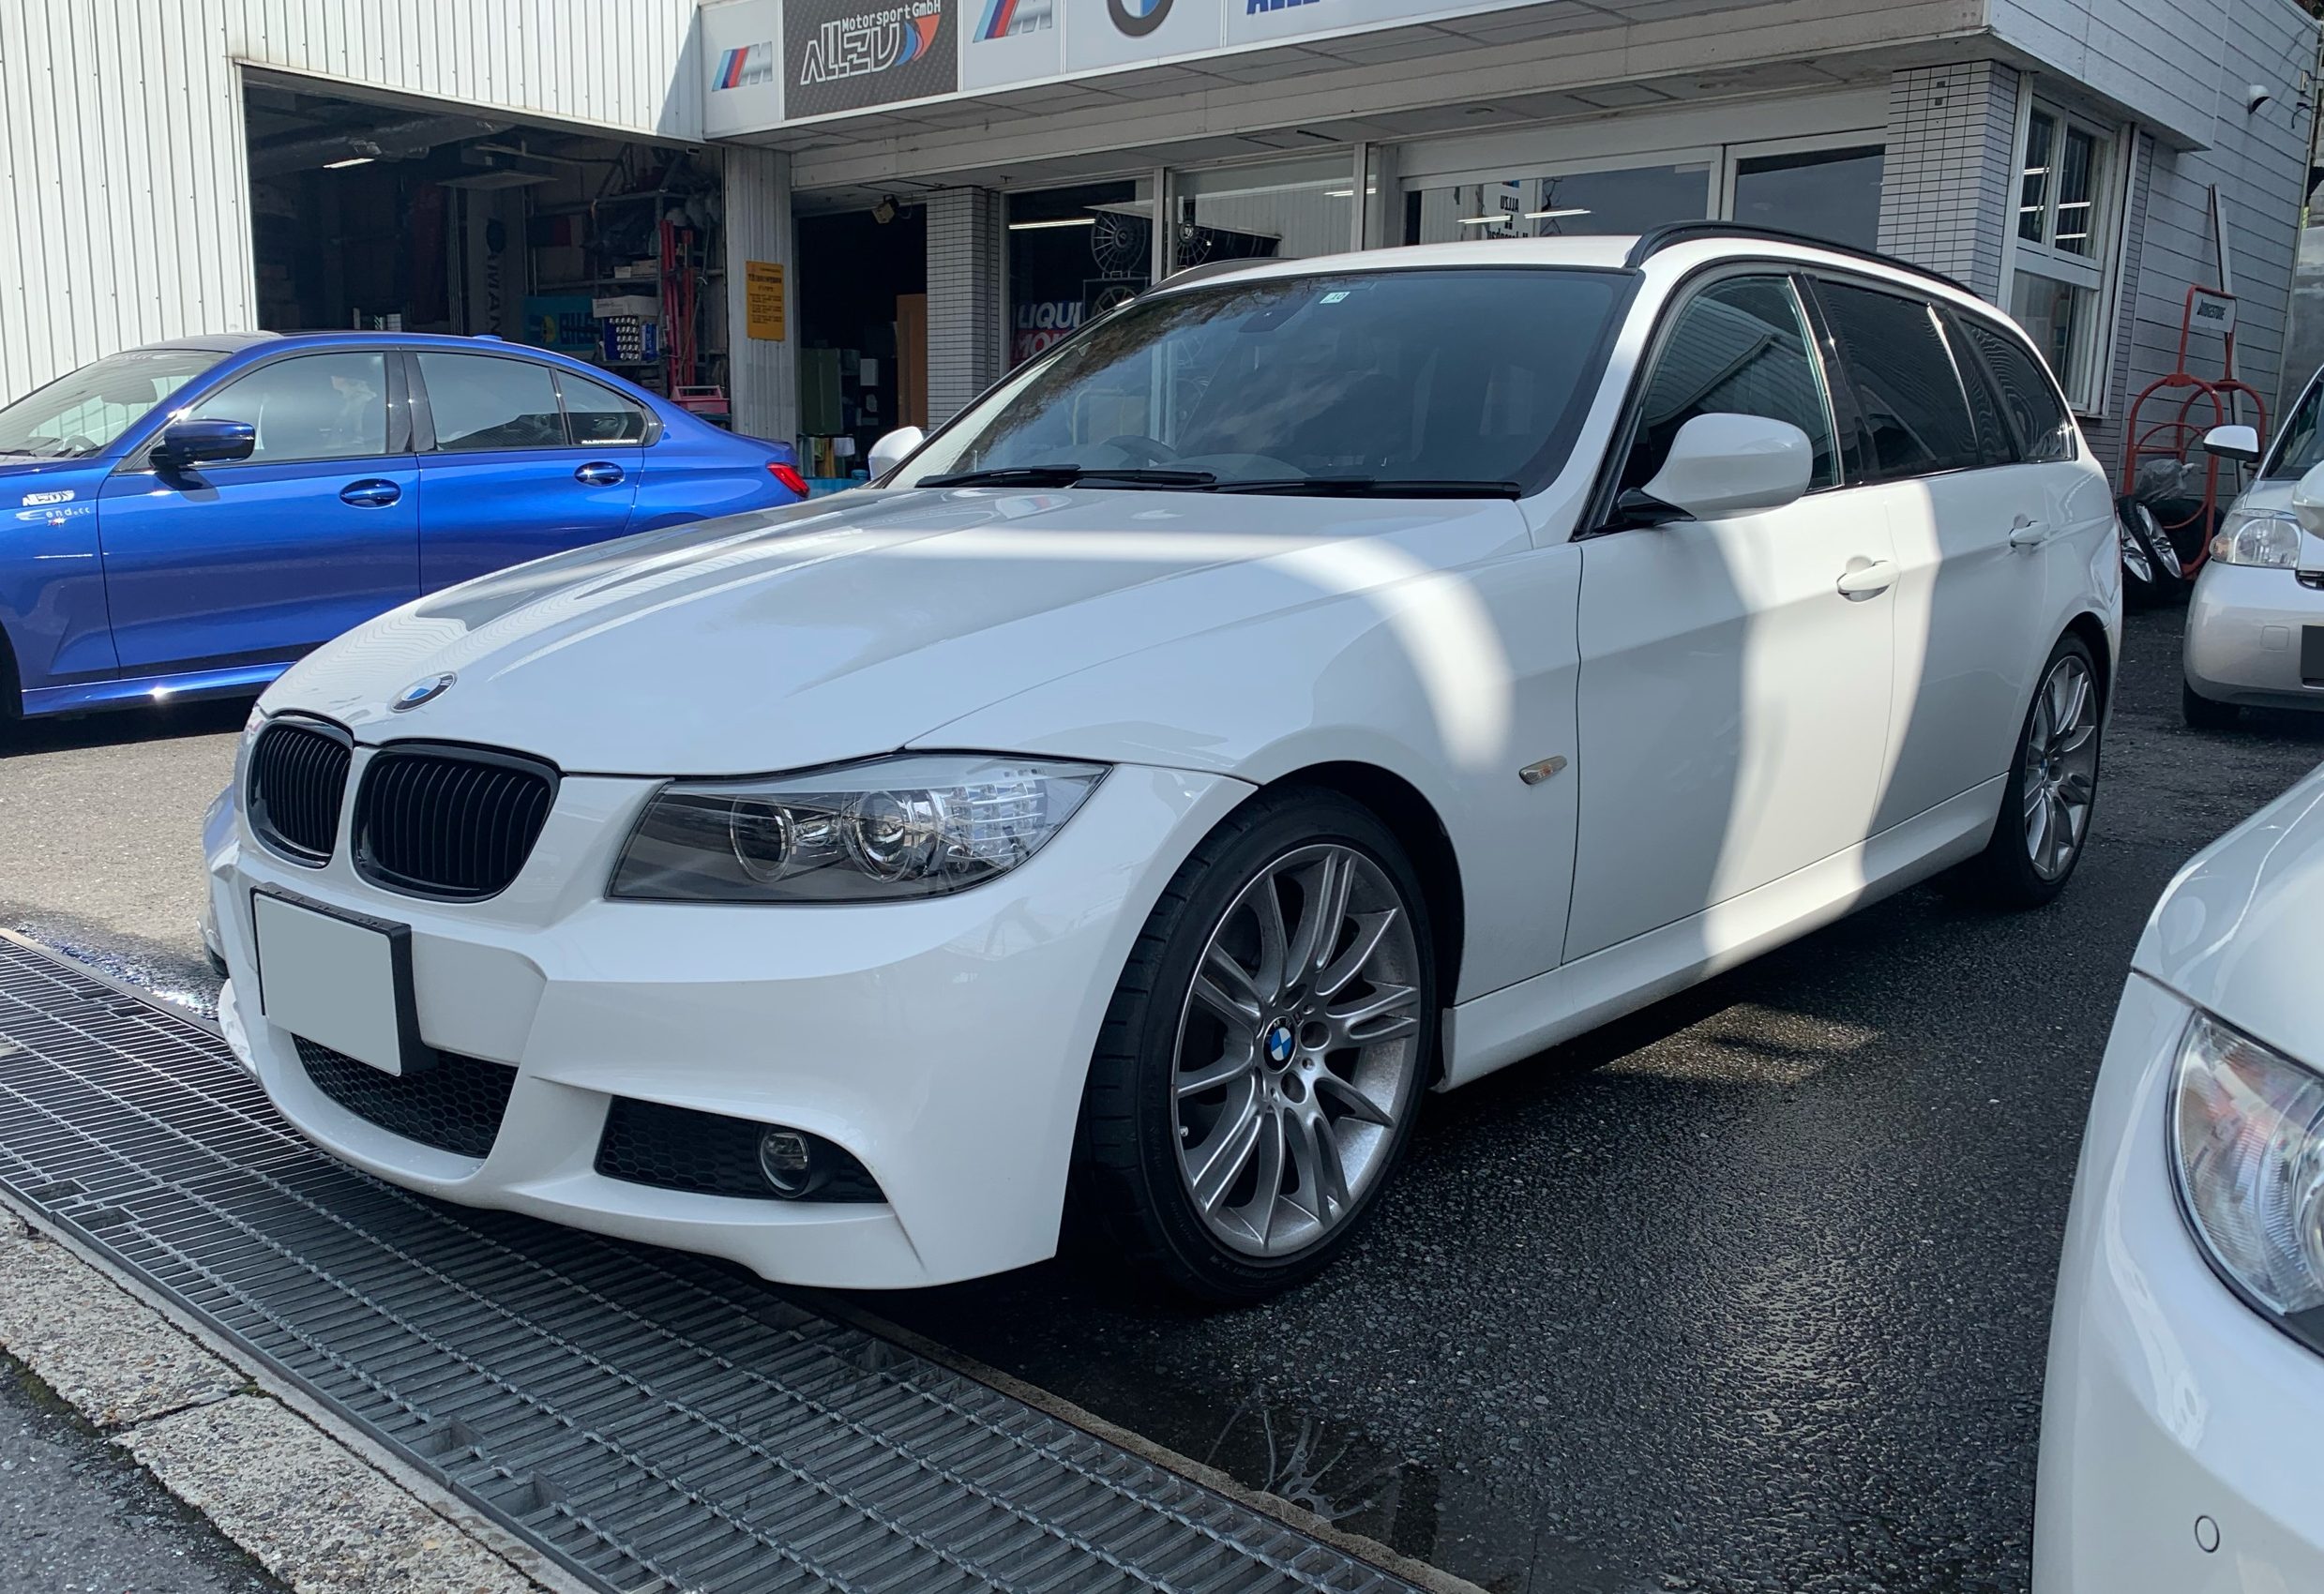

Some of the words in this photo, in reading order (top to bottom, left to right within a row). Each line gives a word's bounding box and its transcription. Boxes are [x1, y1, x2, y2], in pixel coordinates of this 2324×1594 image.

[841, 5, 912, 32] Motorsport
[912, 1, 942, 18] GmbH
[1018, 302, 1083, 328] LIQUI
